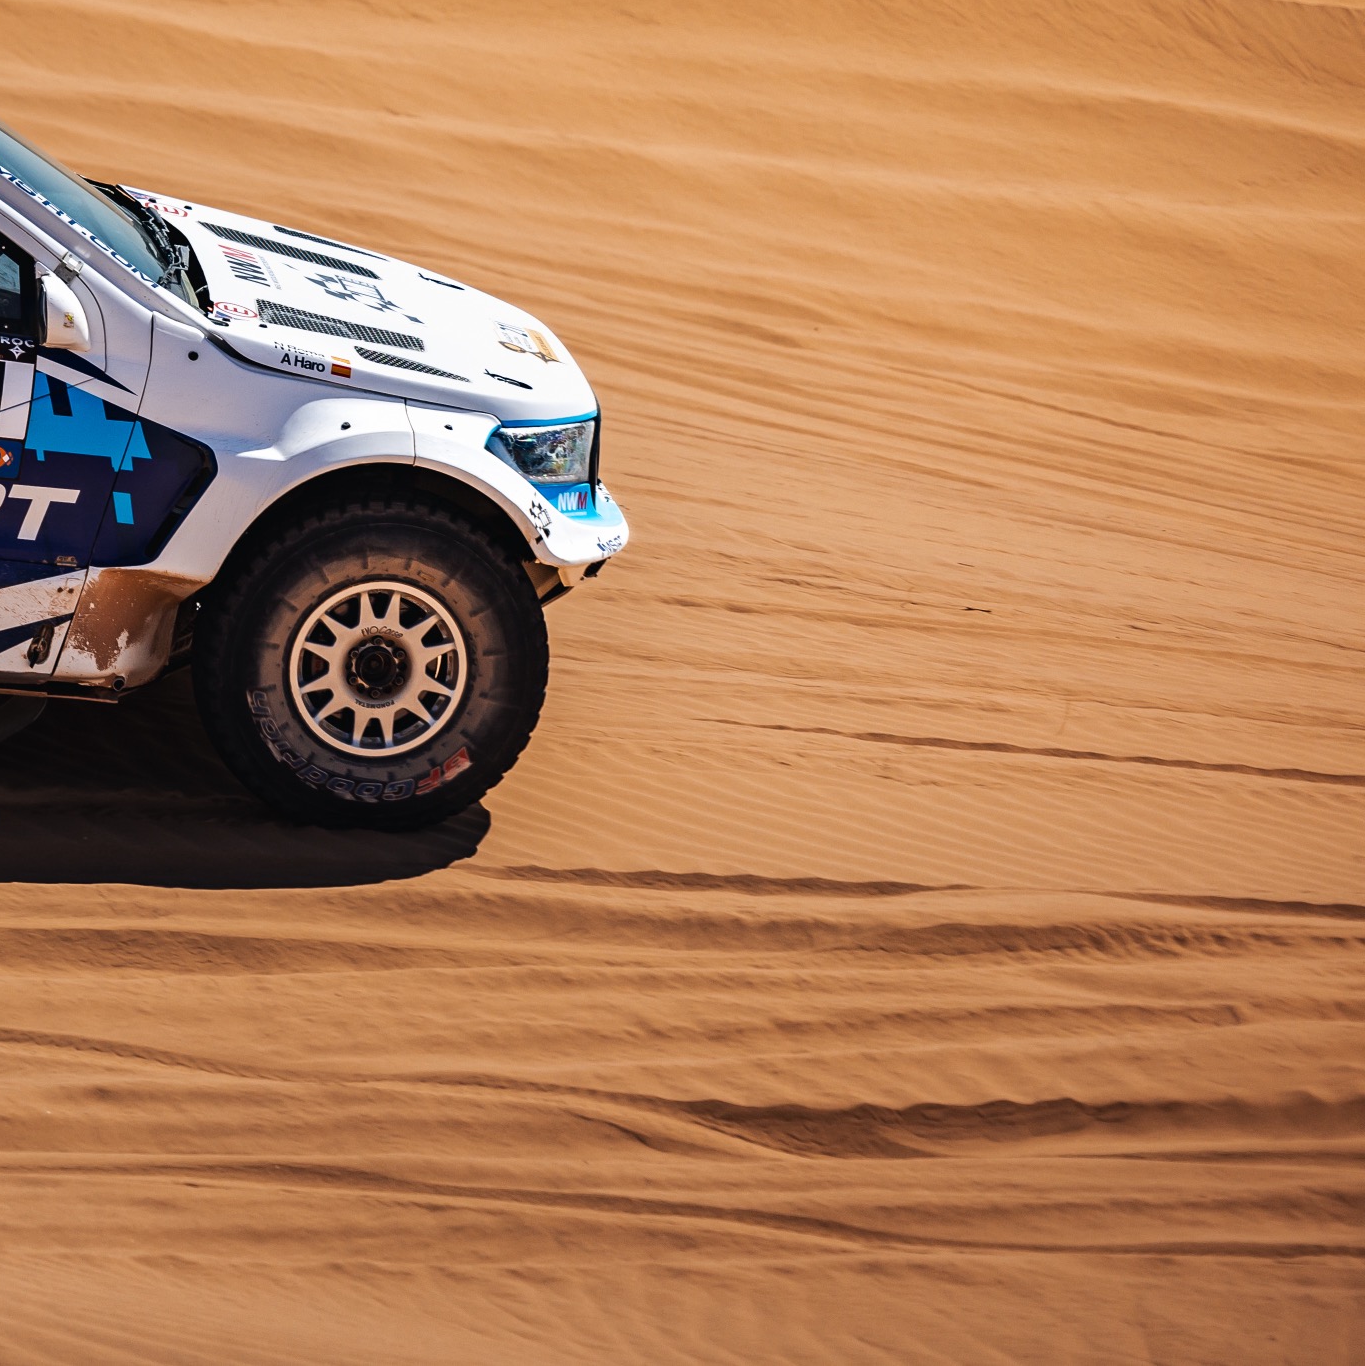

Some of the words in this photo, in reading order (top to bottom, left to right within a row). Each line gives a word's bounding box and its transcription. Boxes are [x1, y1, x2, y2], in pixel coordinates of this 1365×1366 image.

[280, 352, 292, 366] A
[294, 354, 326, 373] Haro
[558, 491, 588, 511] NWM
[354, 698, 396, 710] FONDMETAL
[246, 689, 474, 801] BFGoodrich
